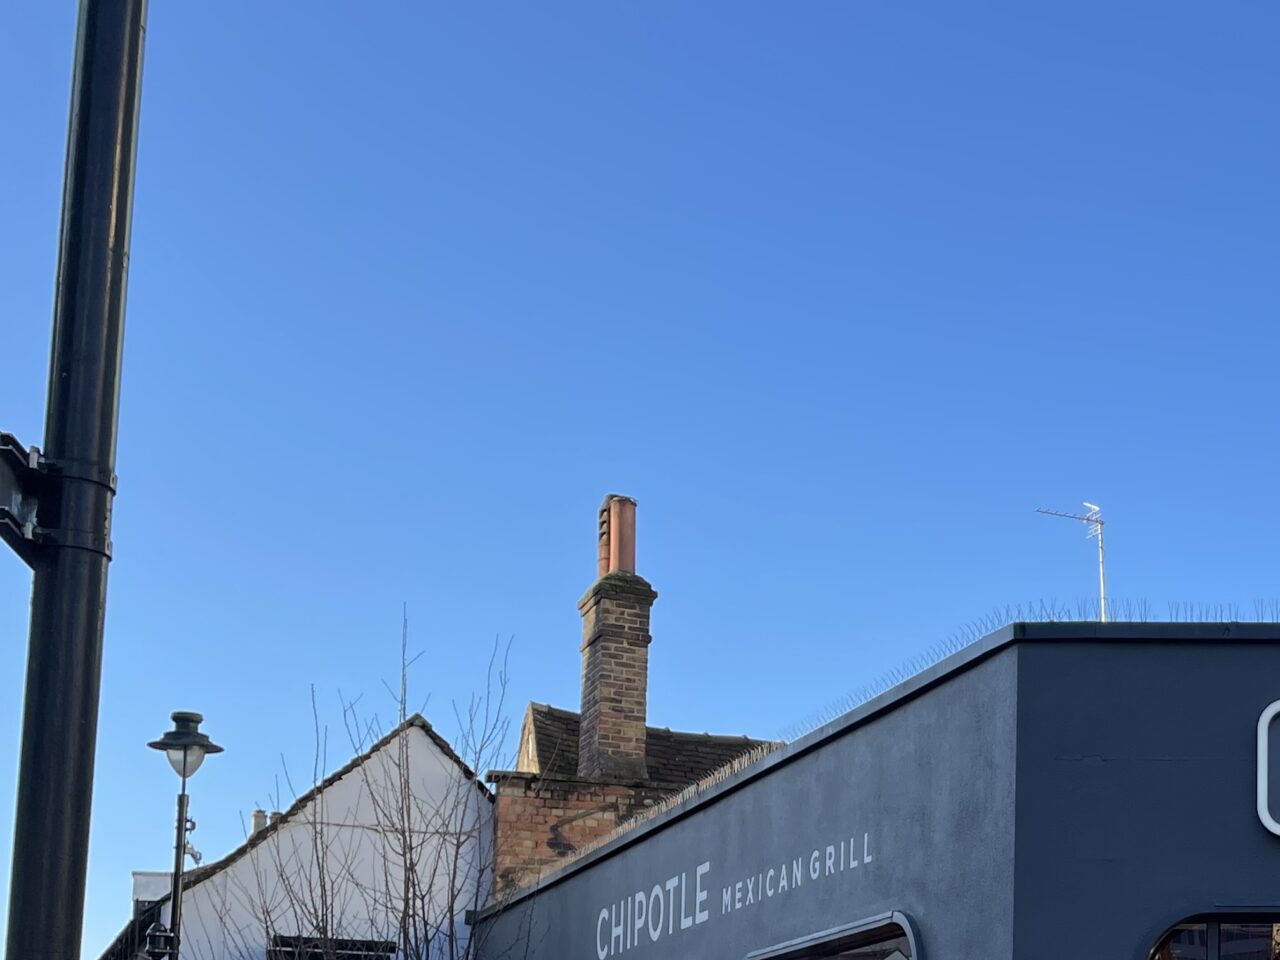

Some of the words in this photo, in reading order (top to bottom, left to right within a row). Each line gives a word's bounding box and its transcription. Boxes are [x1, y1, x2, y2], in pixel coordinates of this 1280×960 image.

[596, 861, 711, 960] CHIPOTLE
[722, 857, 802, 914] MEXICAN
[810, 832, 873, 880] GRILL
